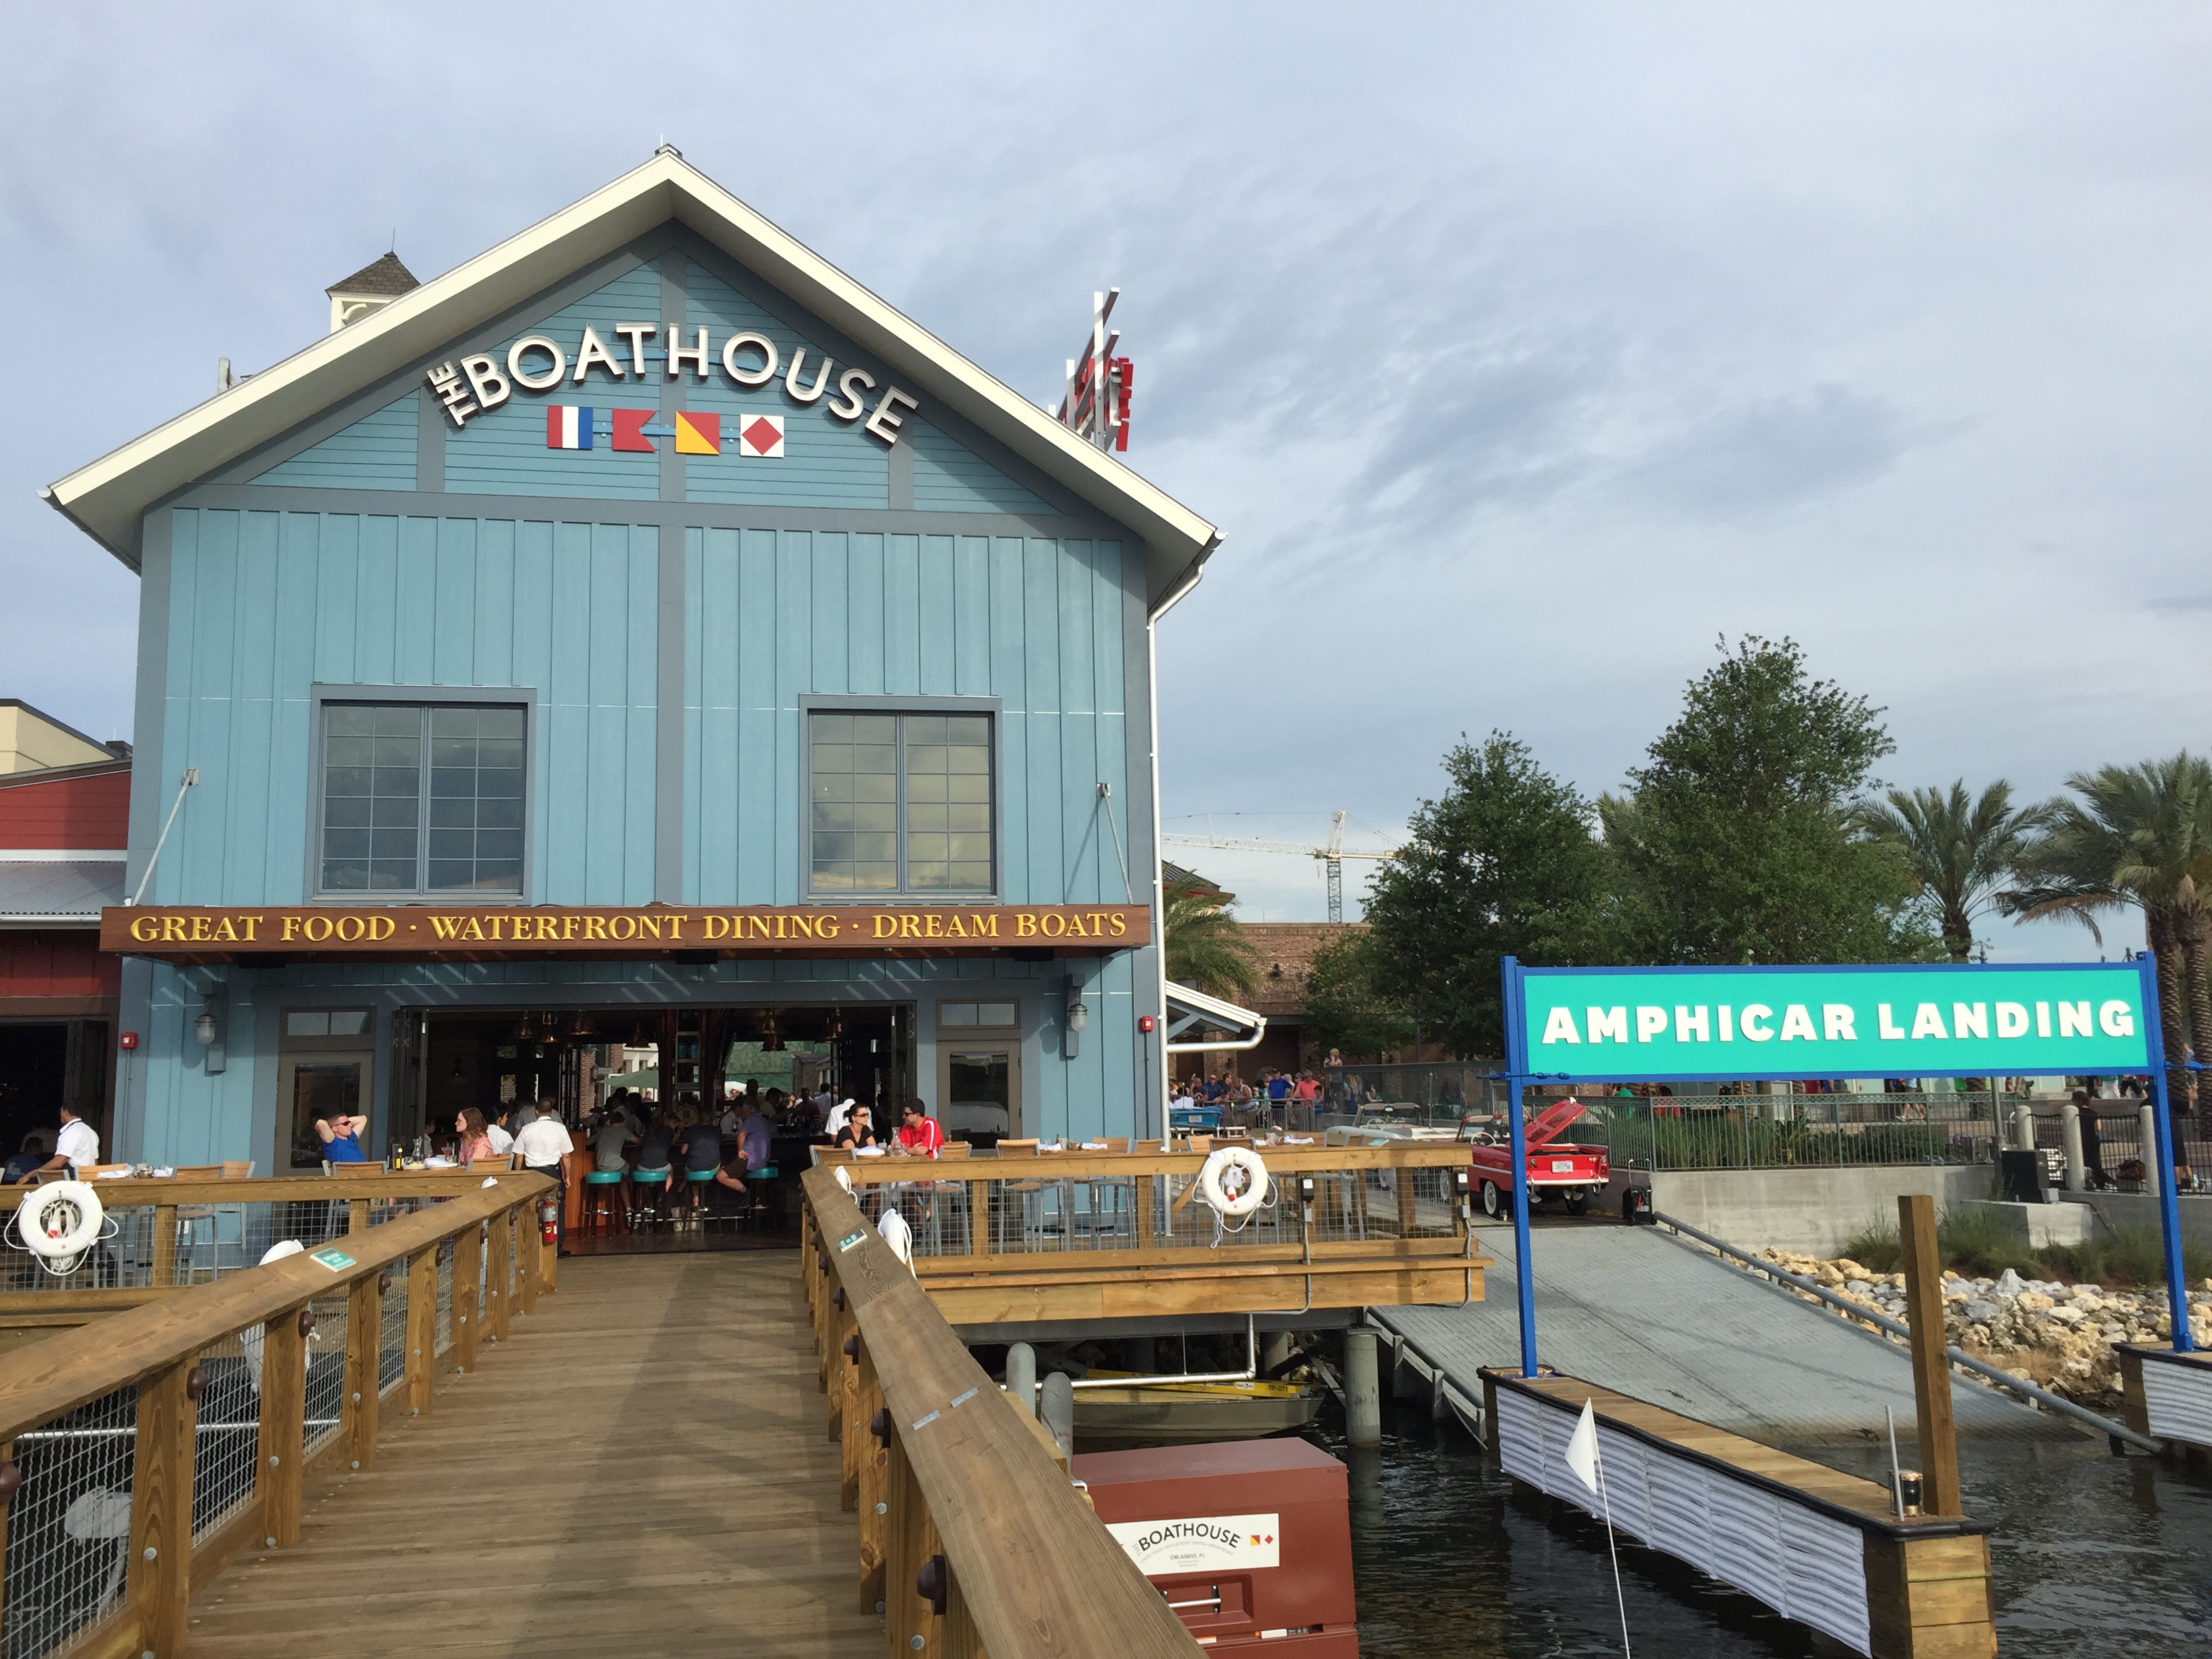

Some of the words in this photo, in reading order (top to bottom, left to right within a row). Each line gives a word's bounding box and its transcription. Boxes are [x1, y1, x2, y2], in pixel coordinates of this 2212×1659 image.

[426, 360, 480, 428] THE
[460, 322, 919, 447] BOATHOUSE
[129, 916, 264, 942] GREAT
[280, 916, 396, 942] FOOD
[427, 914, 688, 942] WATERFRONT
[702, 914, 838, 941] DINING
[872, 914, 1000, 939] DREAM
[1014, 912, 1127, 938] BOATS
[1541, 1003, 1858, 1044] AMPHICAR
[1877, 999, 2135, 1040] LANDING
[1132, 1542, 1143, 1557] THE
[1138, 1523, 1241, 1552] BOATHOUSE
